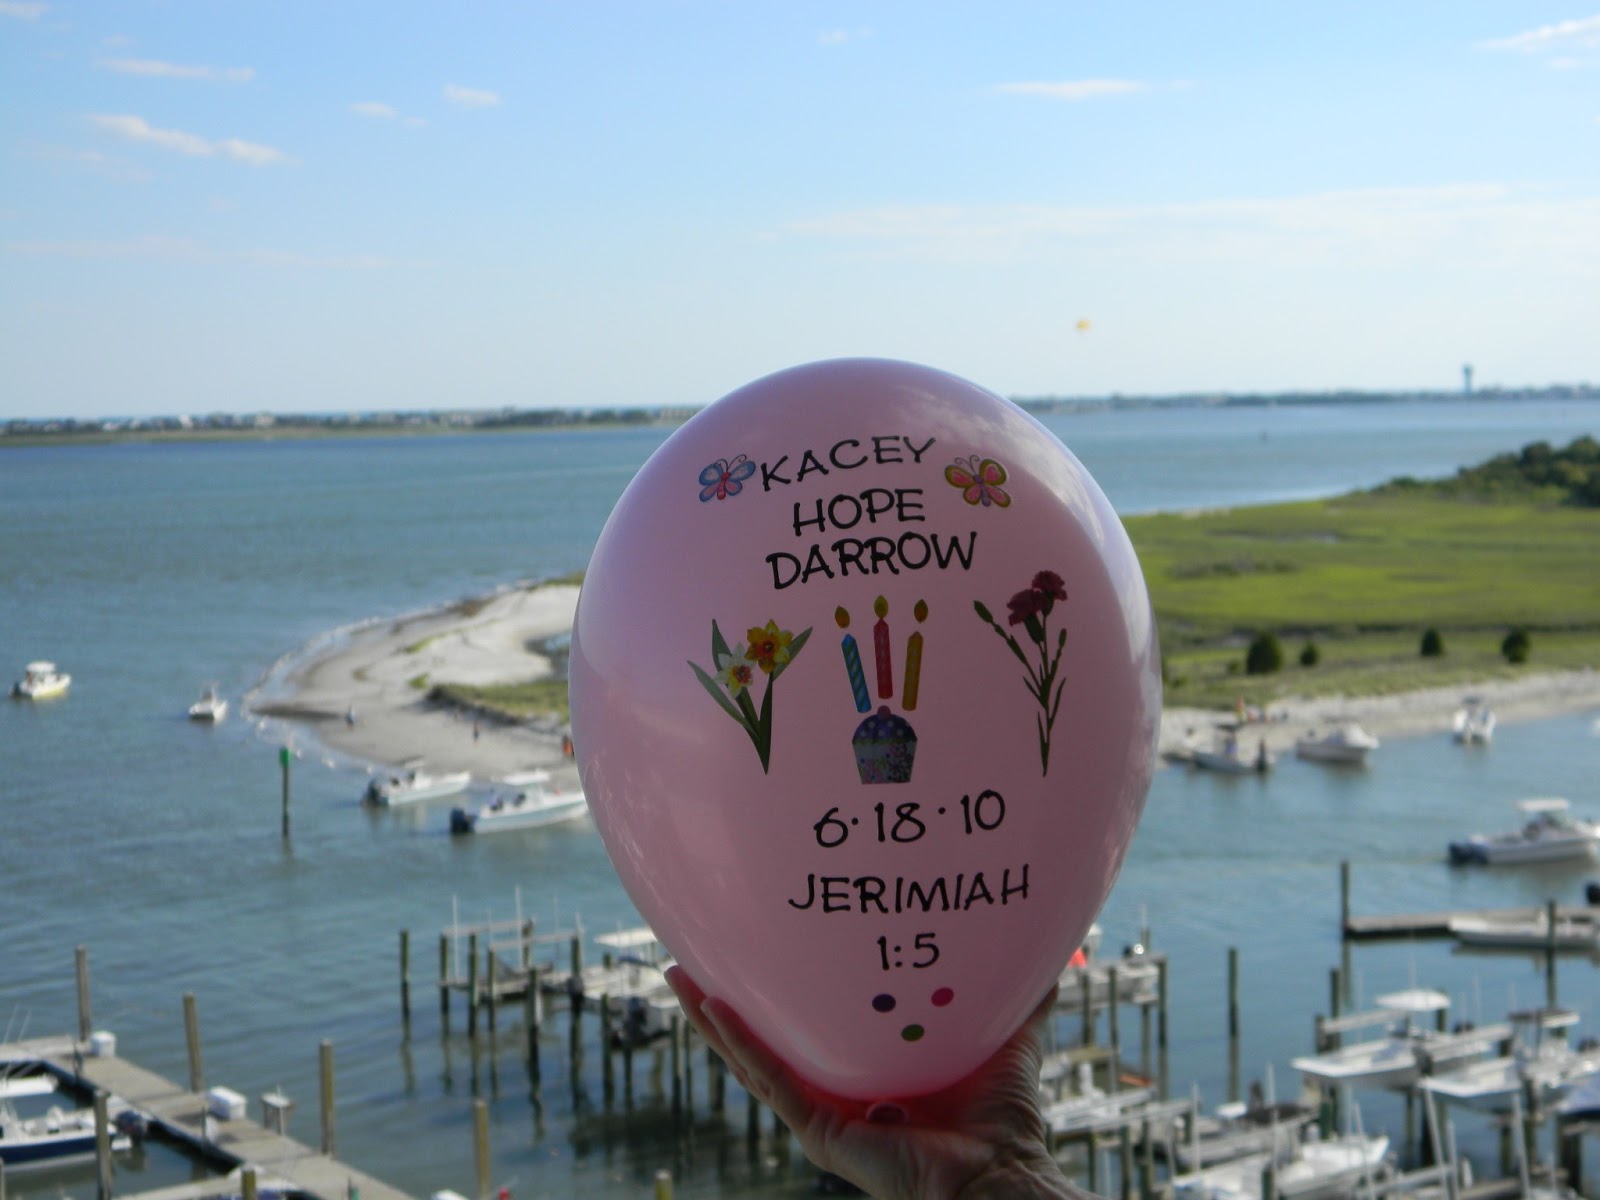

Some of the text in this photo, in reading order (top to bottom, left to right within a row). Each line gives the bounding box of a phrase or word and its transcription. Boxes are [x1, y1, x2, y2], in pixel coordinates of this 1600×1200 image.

[761, 435, 936, 492] KACEY
[792, 487, 926, 537] HOPE
[765, 530, 978, 590] DARROW
[787, 862, 1030, 915] JERIMIAH
[876, 931, 941, 972] 1:5
